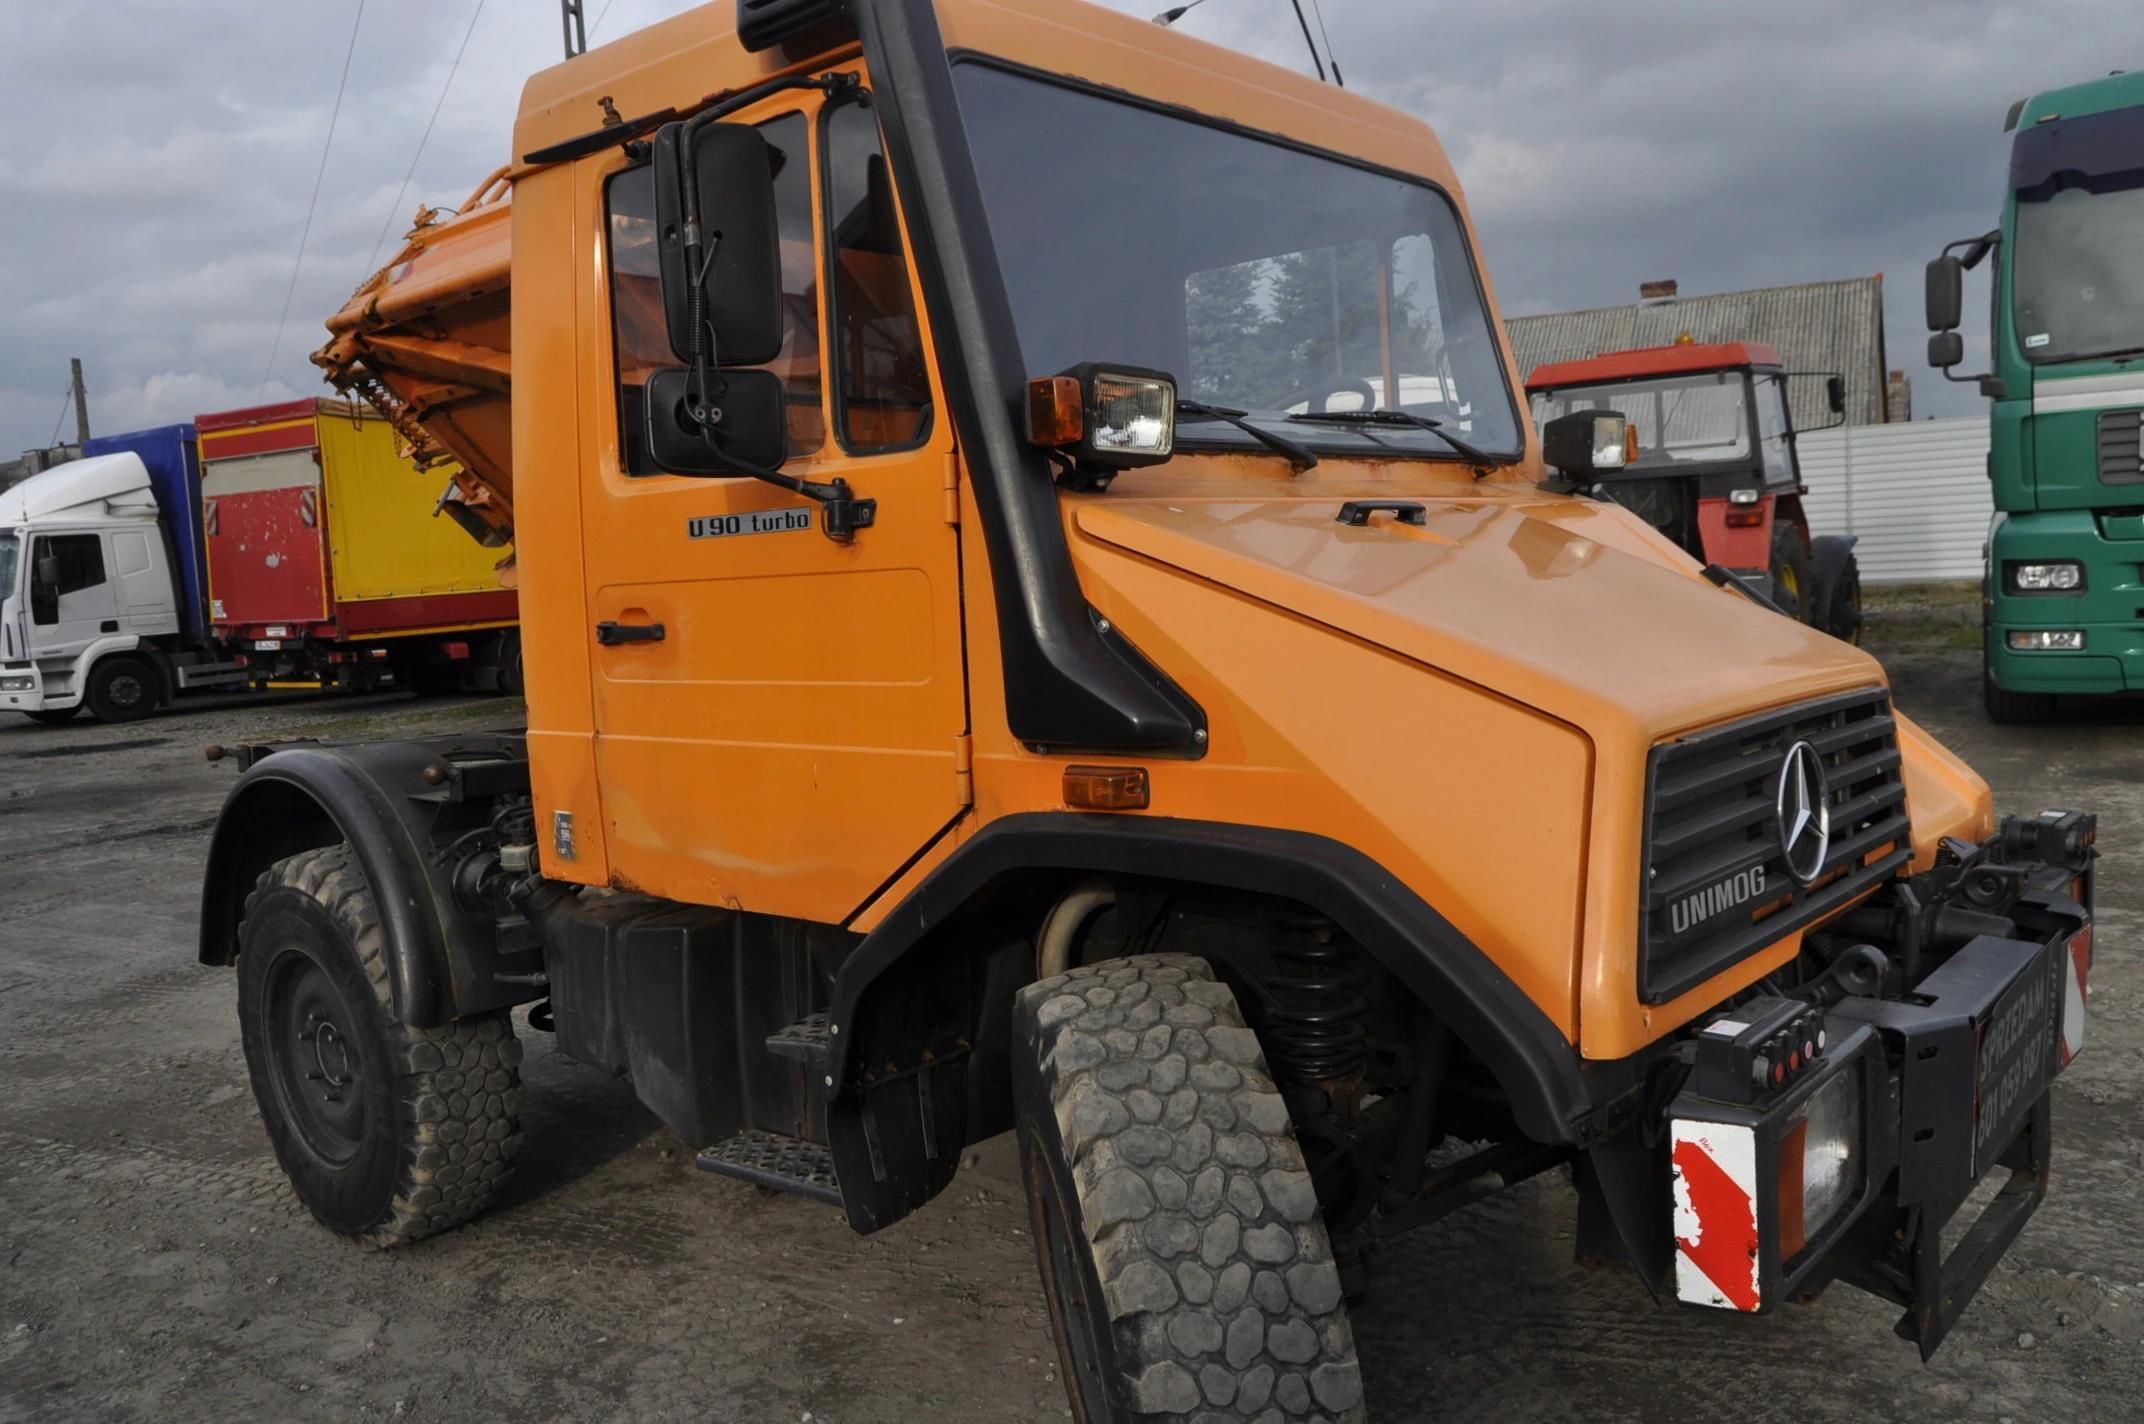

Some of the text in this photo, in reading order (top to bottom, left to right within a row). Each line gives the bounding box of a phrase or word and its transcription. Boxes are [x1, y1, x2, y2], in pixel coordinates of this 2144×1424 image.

[689, 512, 808, 537] U 90 turbo
[1672, 865, 1765, 934] UNIMOG
[1980, 974, 2044, 1082] SPRZEDAM
